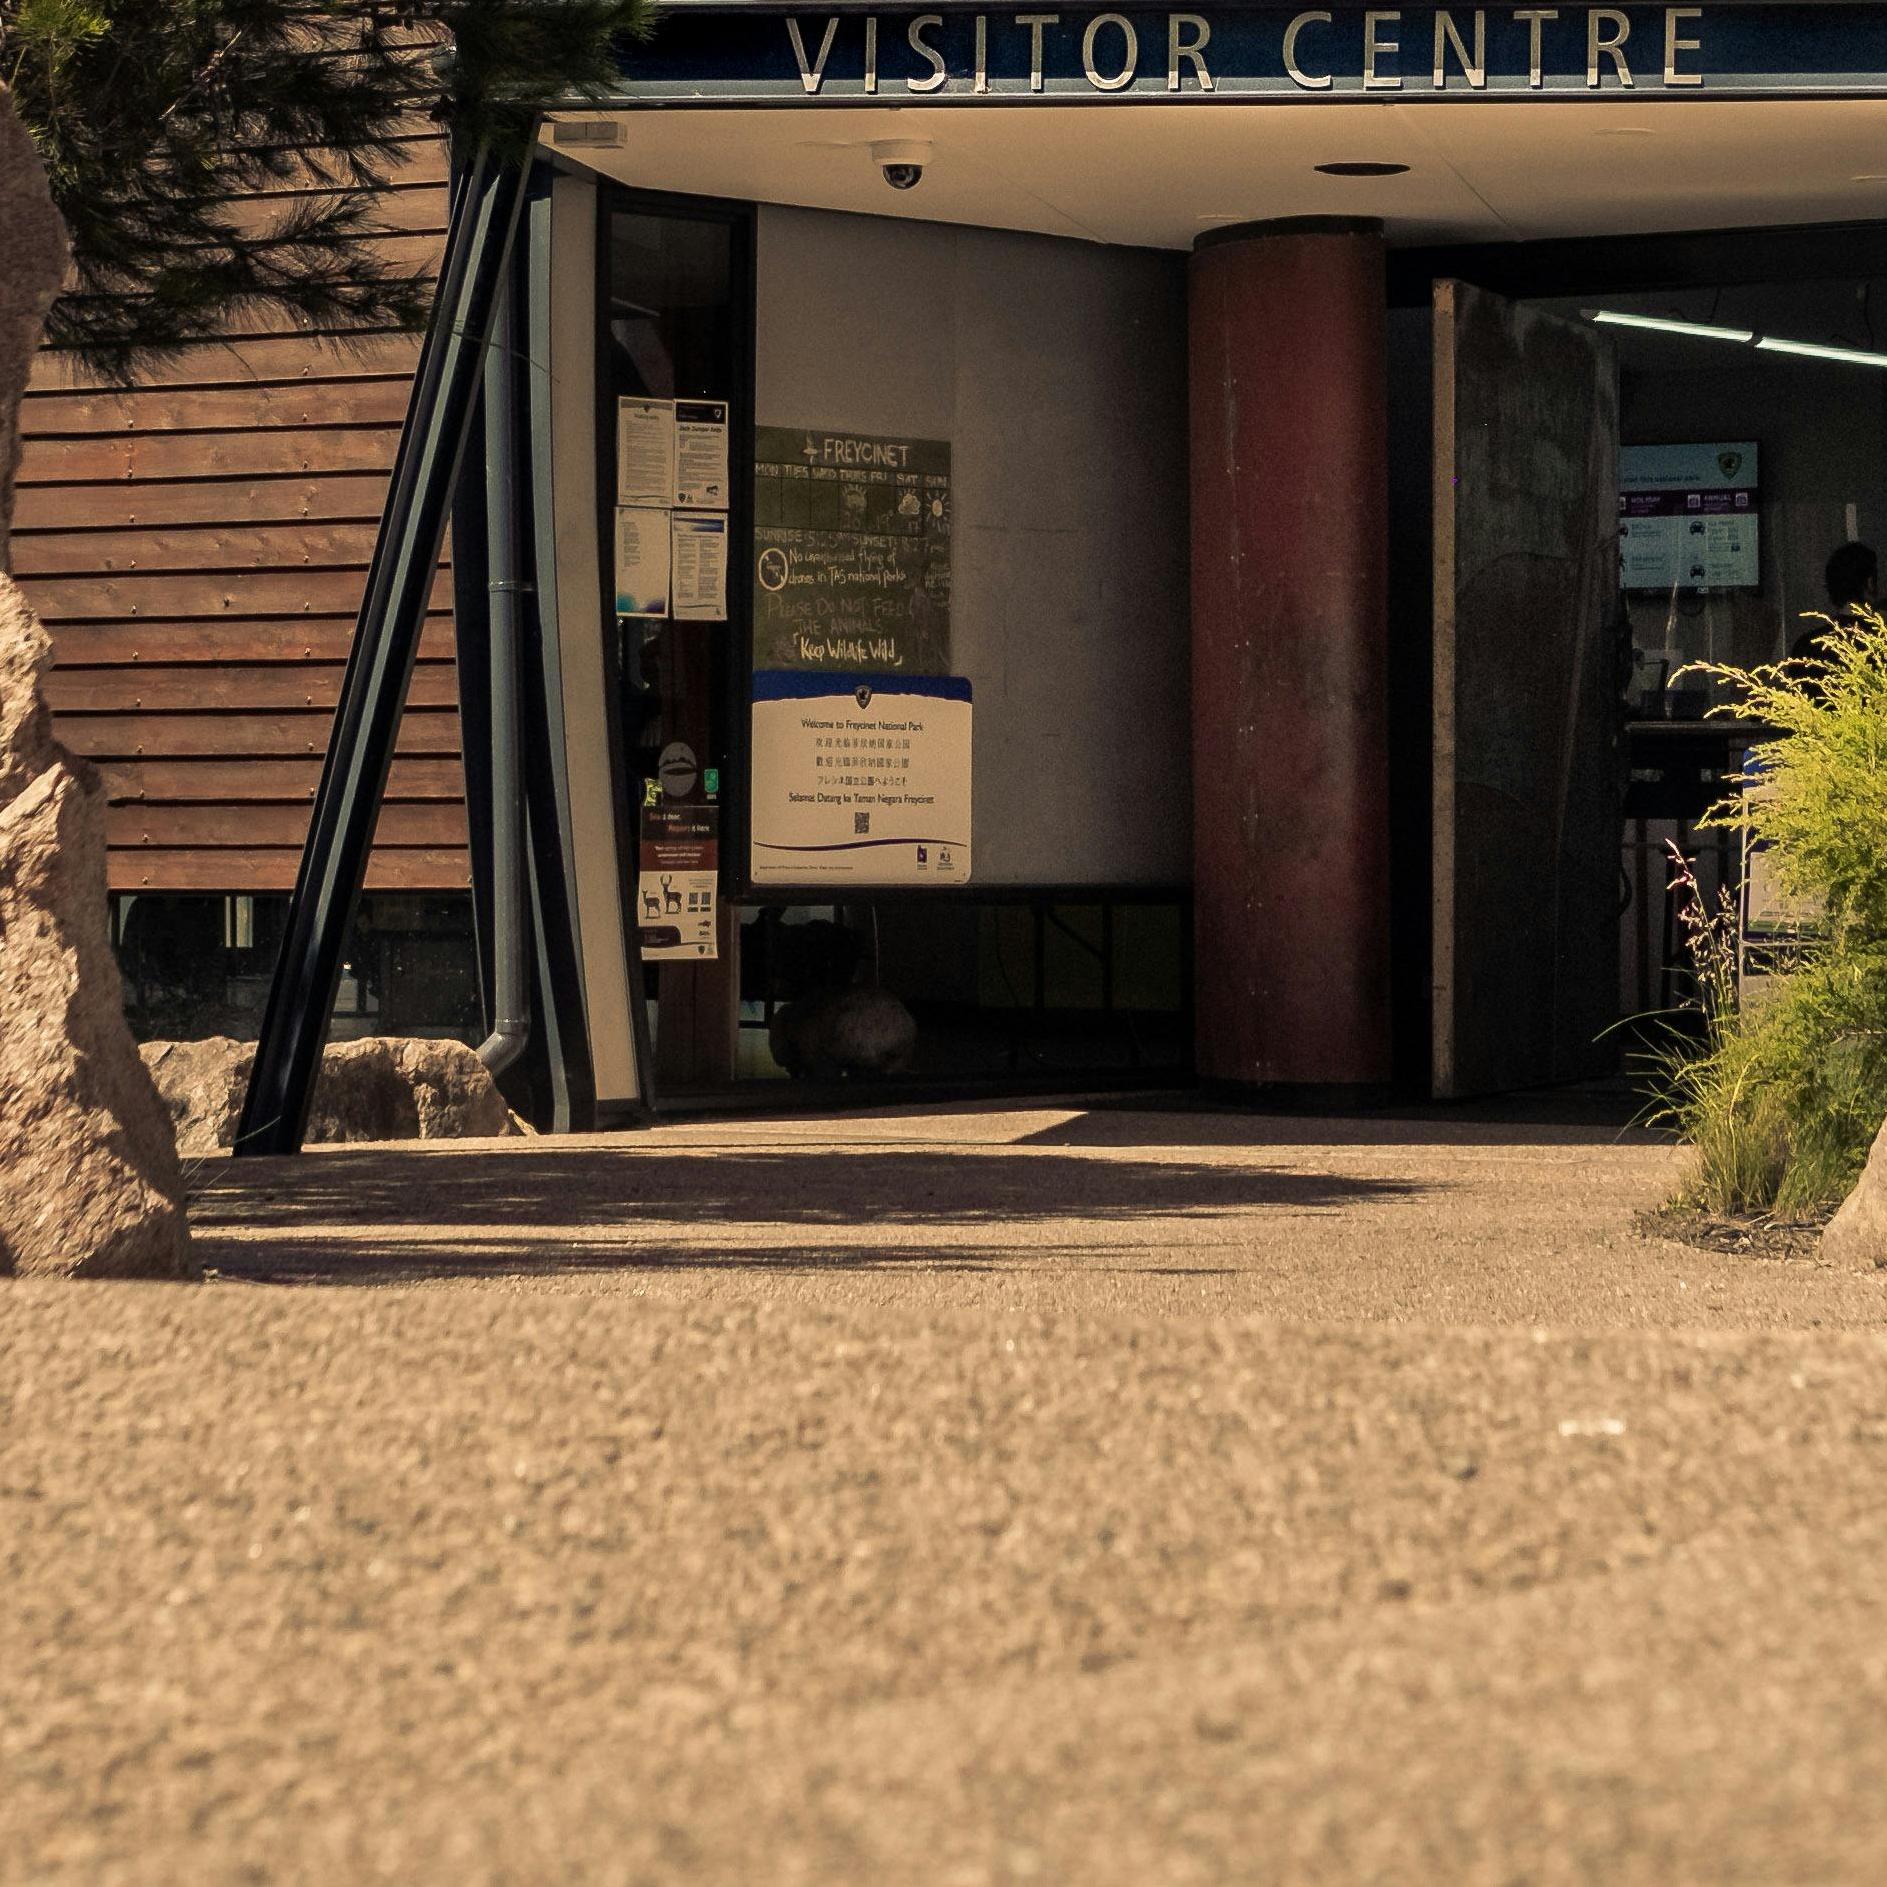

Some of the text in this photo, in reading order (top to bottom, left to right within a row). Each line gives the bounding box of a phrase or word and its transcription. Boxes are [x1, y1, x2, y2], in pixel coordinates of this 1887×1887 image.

[785, 7, 1706, 92] VISITOR CENTRE
[823, 438, 910, 467] FREYCINET
[801, 718, 923, 732] Welcome to Freycinet National Park
[853, 793, 876, 803] Taman
[877, 794, 903, 806] Negara
[904, 794, 934, 806] Freycinet
